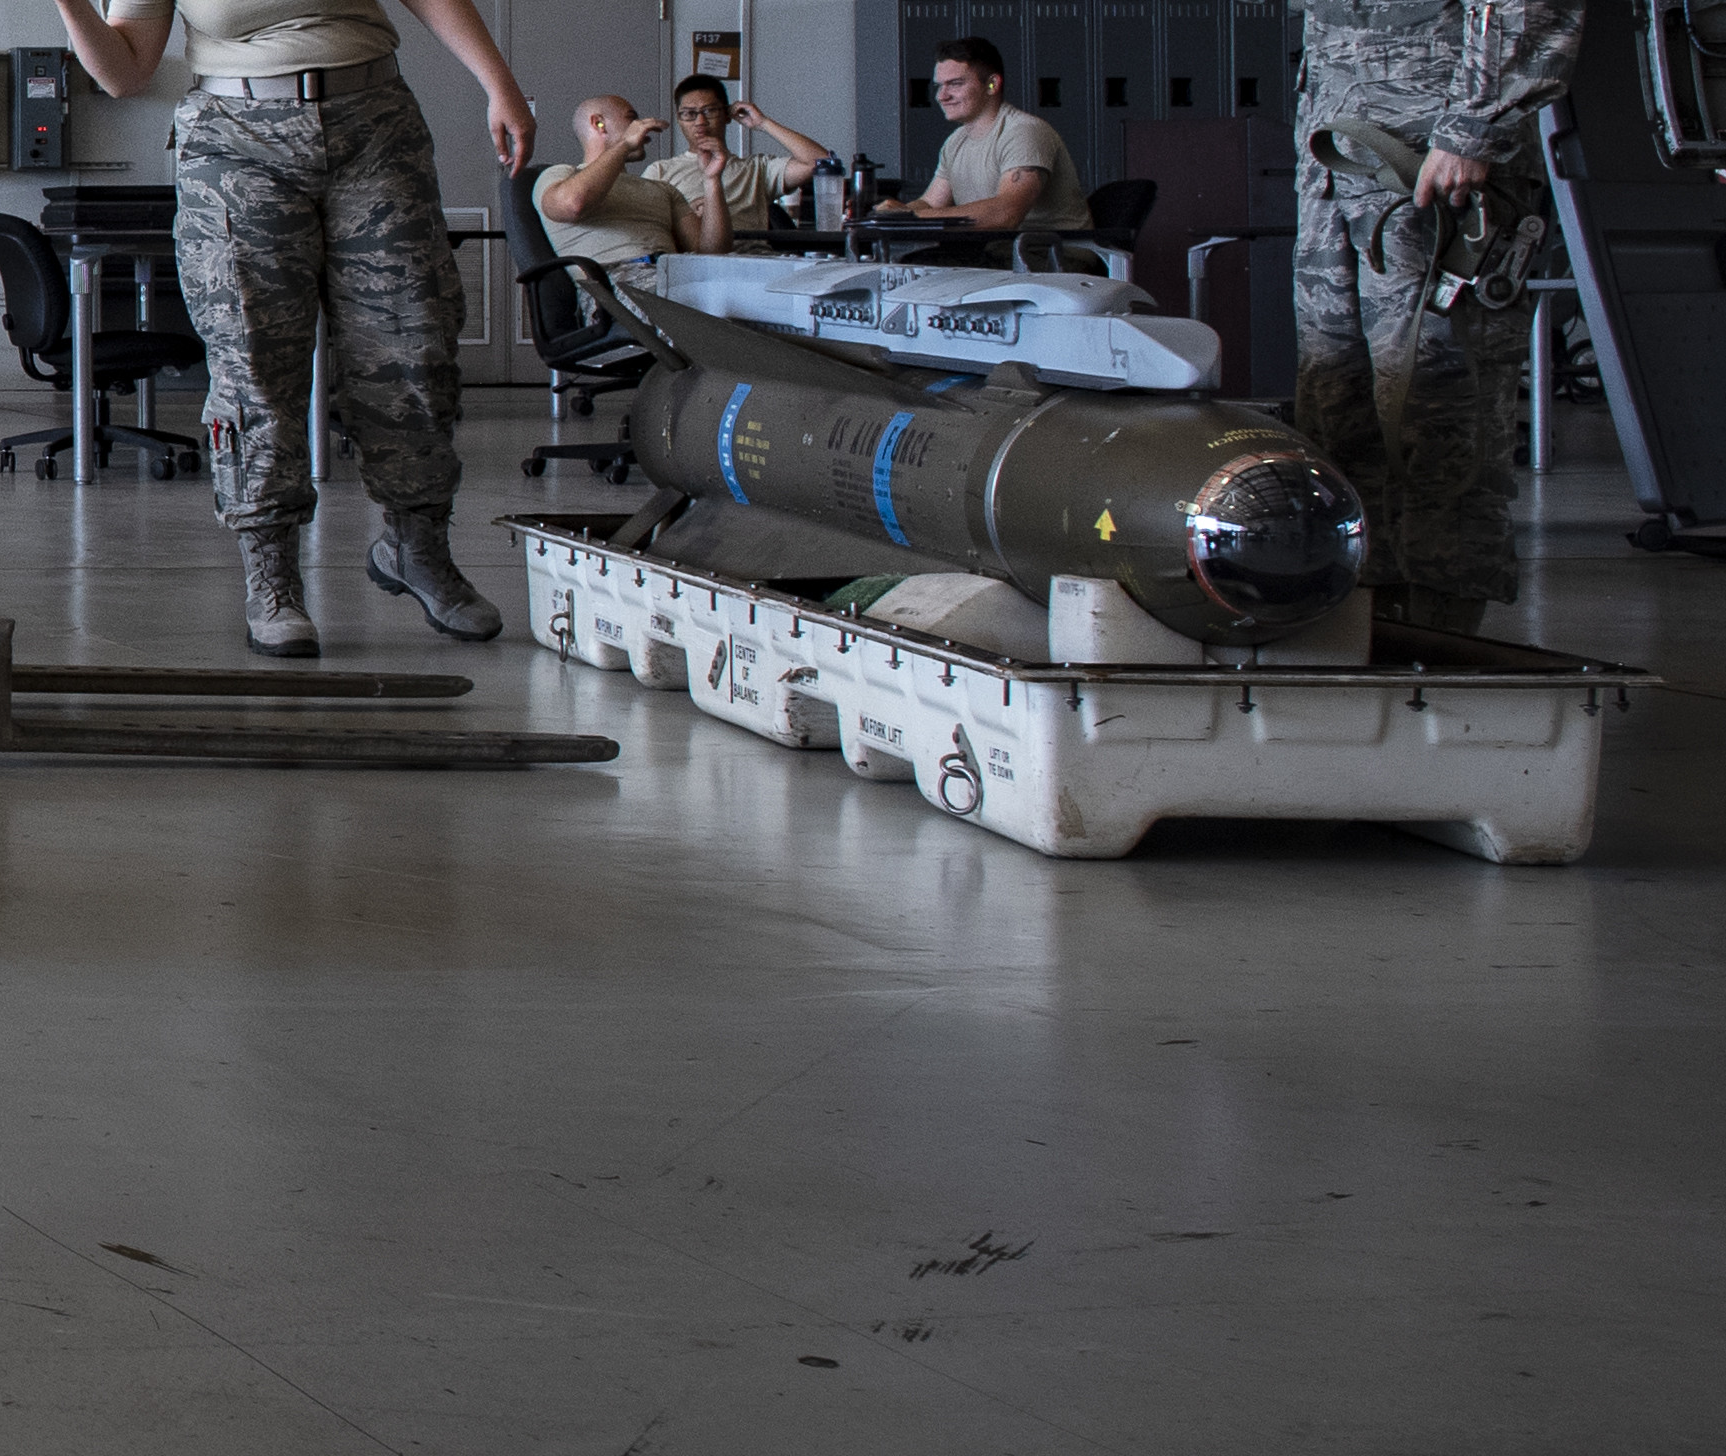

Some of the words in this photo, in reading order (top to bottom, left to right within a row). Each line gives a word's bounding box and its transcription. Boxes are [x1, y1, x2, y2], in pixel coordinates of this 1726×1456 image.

[695, 34, 720, 44] F137
[850, 420, 882, 458] AIR
[881, 425, 935, 468] FORCE
[735, 644, 756, 664] CENTER
[860, 715, 869, 731] NO
[869, 719, 887, 738] FORK
[888, 726, 903, 745] LIFT
